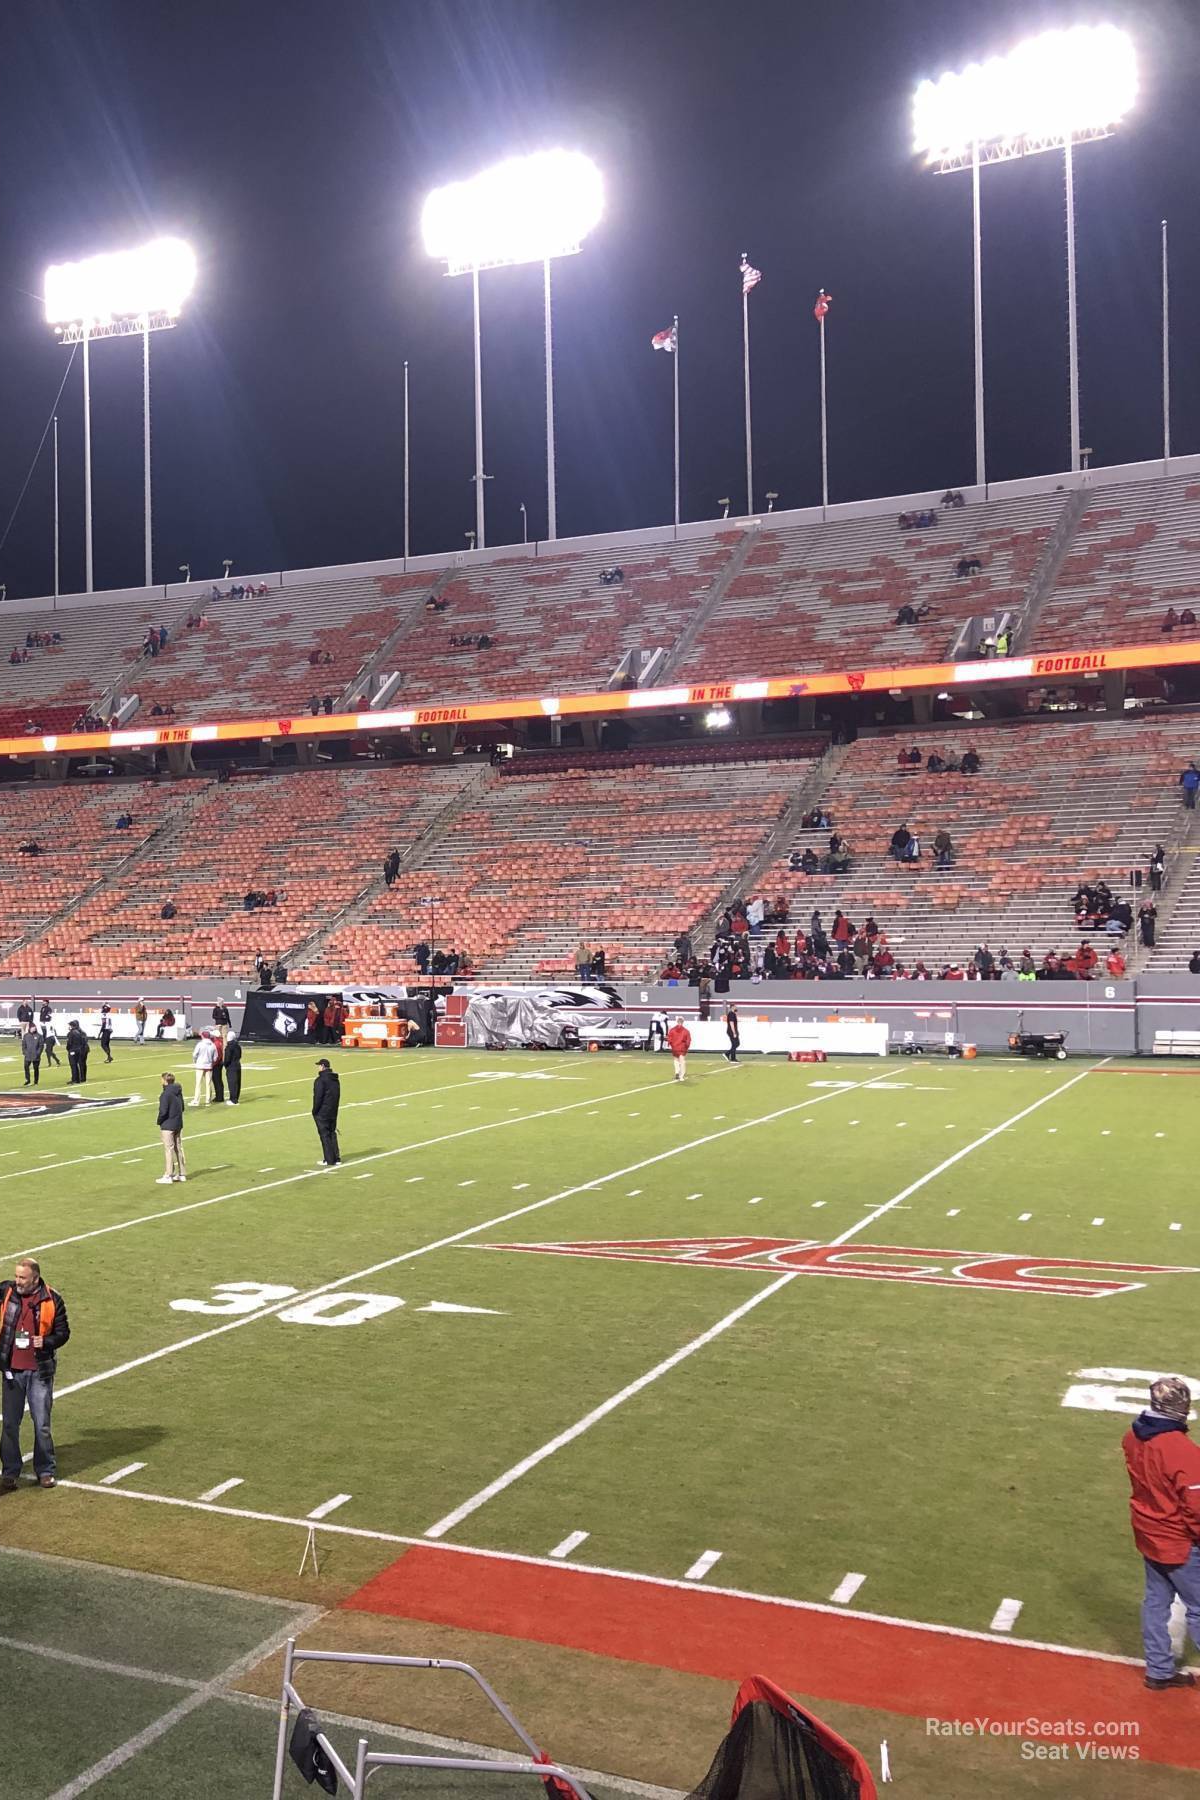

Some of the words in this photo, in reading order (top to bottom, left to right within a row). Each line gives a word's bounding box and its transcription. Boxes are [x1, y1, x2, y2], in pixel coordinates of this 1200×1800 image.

[1036, 654, 1107, 673] FOOTBALL
[691, 688, 706, 700] IN
[710, 686, 732, 699] THE
[418, 708, 467, 723] FOOTBALL
[160, 731, 170, 741] IN
[173, 729, 190, 740] THE
[640, 992, 648, 1002] 5
[1105, 987, 1115, 998] 6
[452, 1236, 1200, 1298] ACC
[169, 1281, 406, 1326] 30
